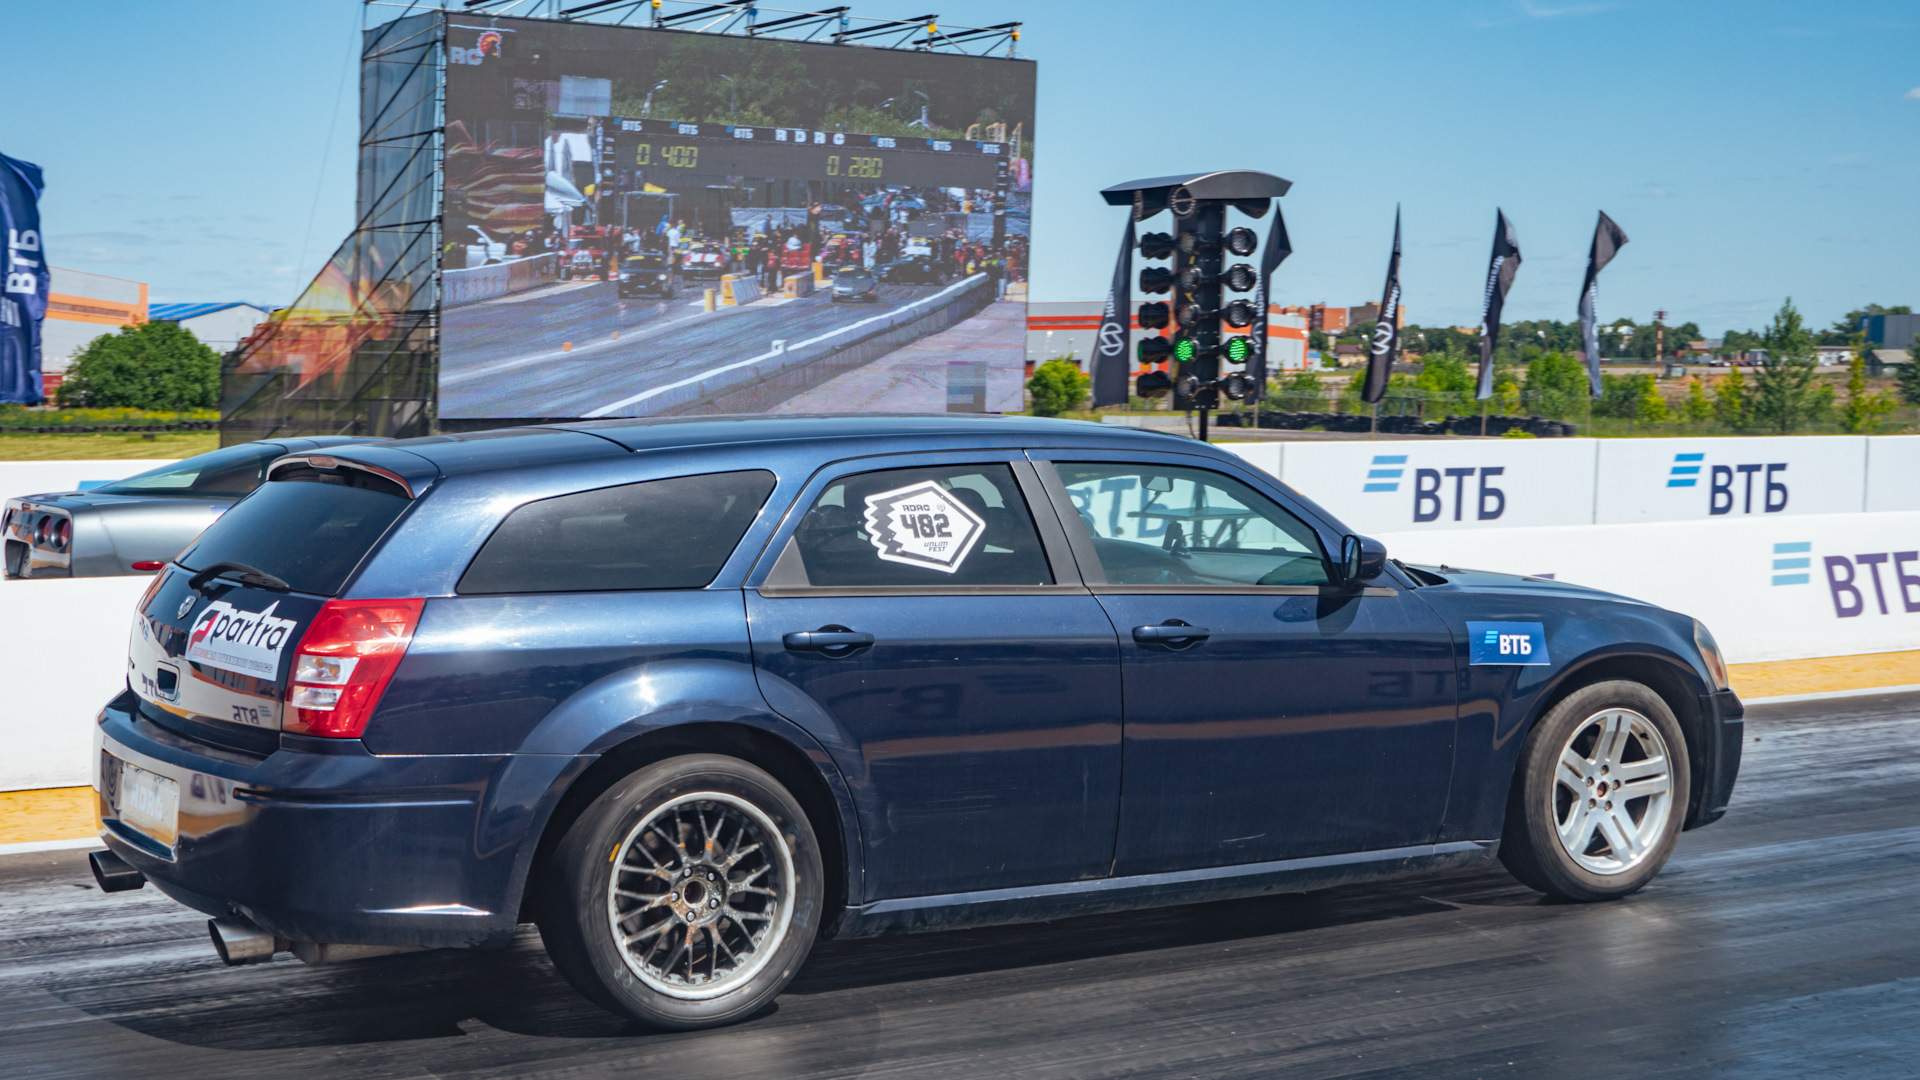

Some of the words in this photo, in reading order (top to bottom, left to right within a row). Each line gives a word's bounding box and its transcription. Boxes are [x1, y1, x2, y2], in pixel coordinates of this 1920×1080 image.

[621, 120, 642, 131] ВТБ
[678, 124, 699, 136] ВТБ
[733, 128, 754, 139] ВТБ
[6, 228, 40, 295] ВТБ
[1412, 466, 1506, 523] ВТБ
[1709, 462, 1789, 516] ВТБ
[900, 514, 952, 538] 482
[1499, 634, 1532, 655] ВТБ
